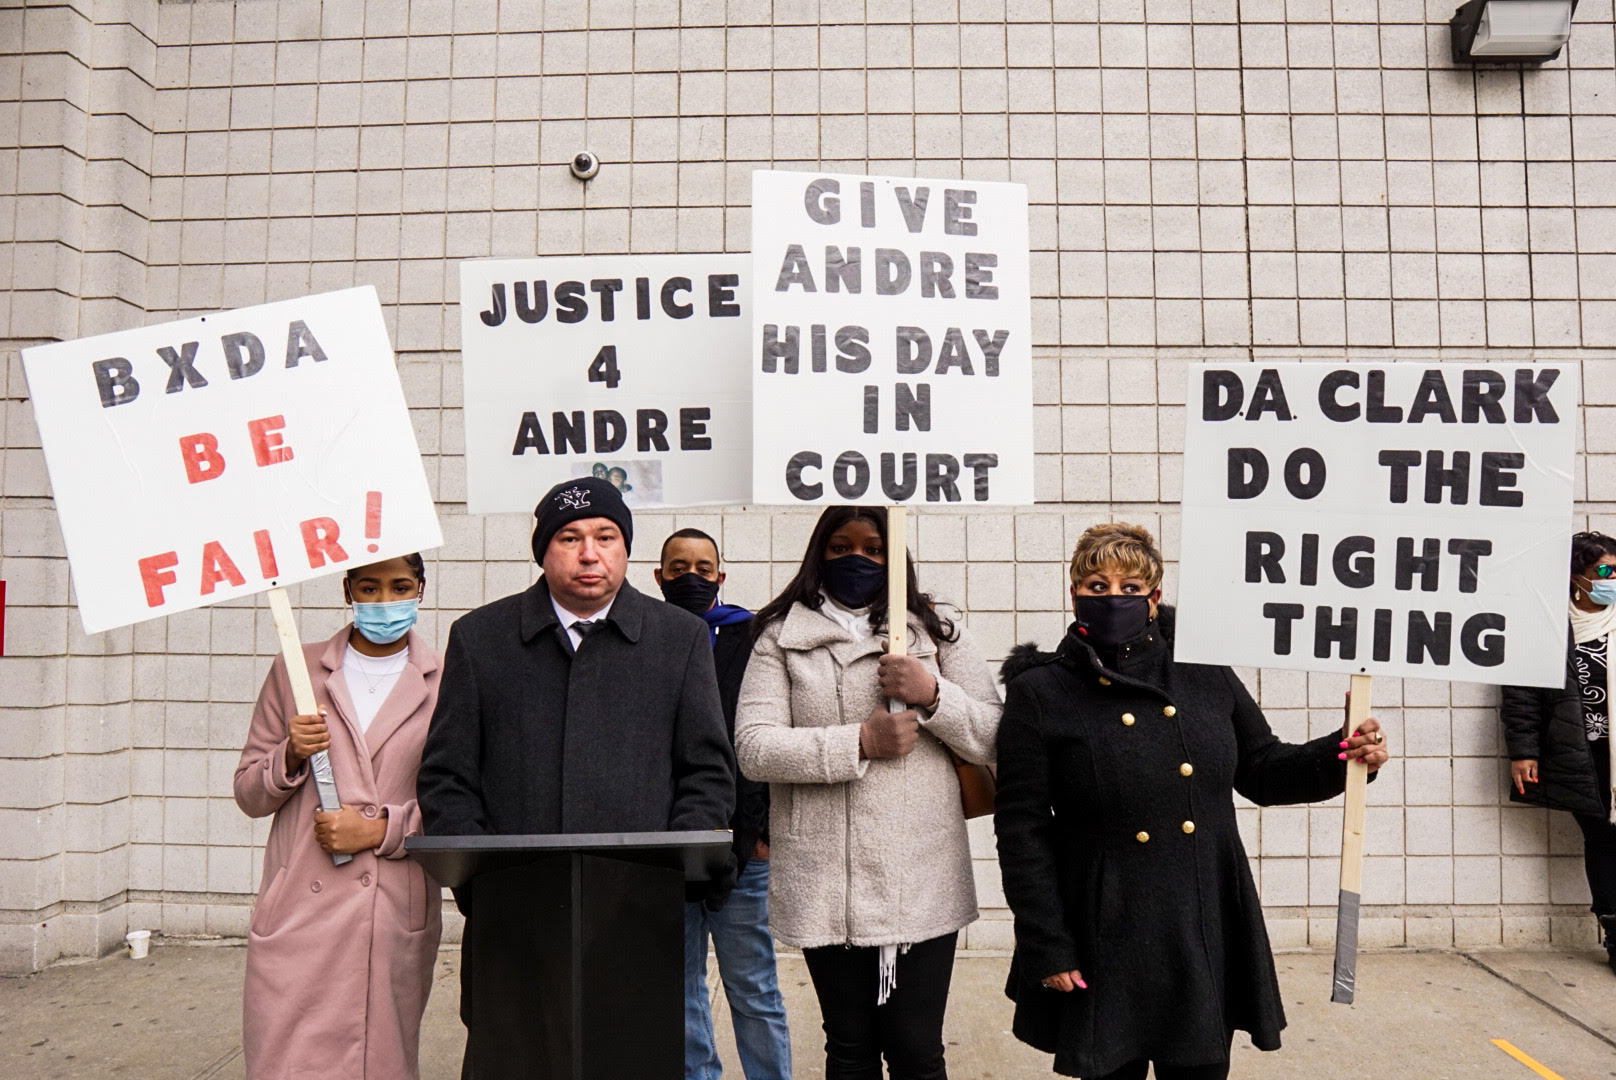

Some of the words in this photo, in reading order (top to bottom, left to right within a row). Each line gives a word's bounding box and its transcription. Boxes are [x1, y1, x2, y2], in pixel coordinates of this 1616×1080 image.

[805, 174, 977, 236] GIVE
[776, 245, 998, 299] ANDRE
[480, 274, 740, 327] JUSTICE
[588, 345, 621, 388] 4
[762, 324, 871, 374] HIS
[897, 326, 1009, 376] DAY
[864, 383, 931, 434] IN
[1203, 369, 1297, 421] D.A.
[1318, 369, 1560, 424] CLARK
[180, 416, 293, 484] BE
[512, 407, 712, 455] ANDRE
[786, 450, 998, 502] COURT
[1228, 447, 1326, 500] DO
[1378, 450, 1525, 507] THE
[138, 491, 382, 608] FAIR!
[1245, 531, 1492, 593] RIGHT
[1263, 602, 1506, 667] THING
